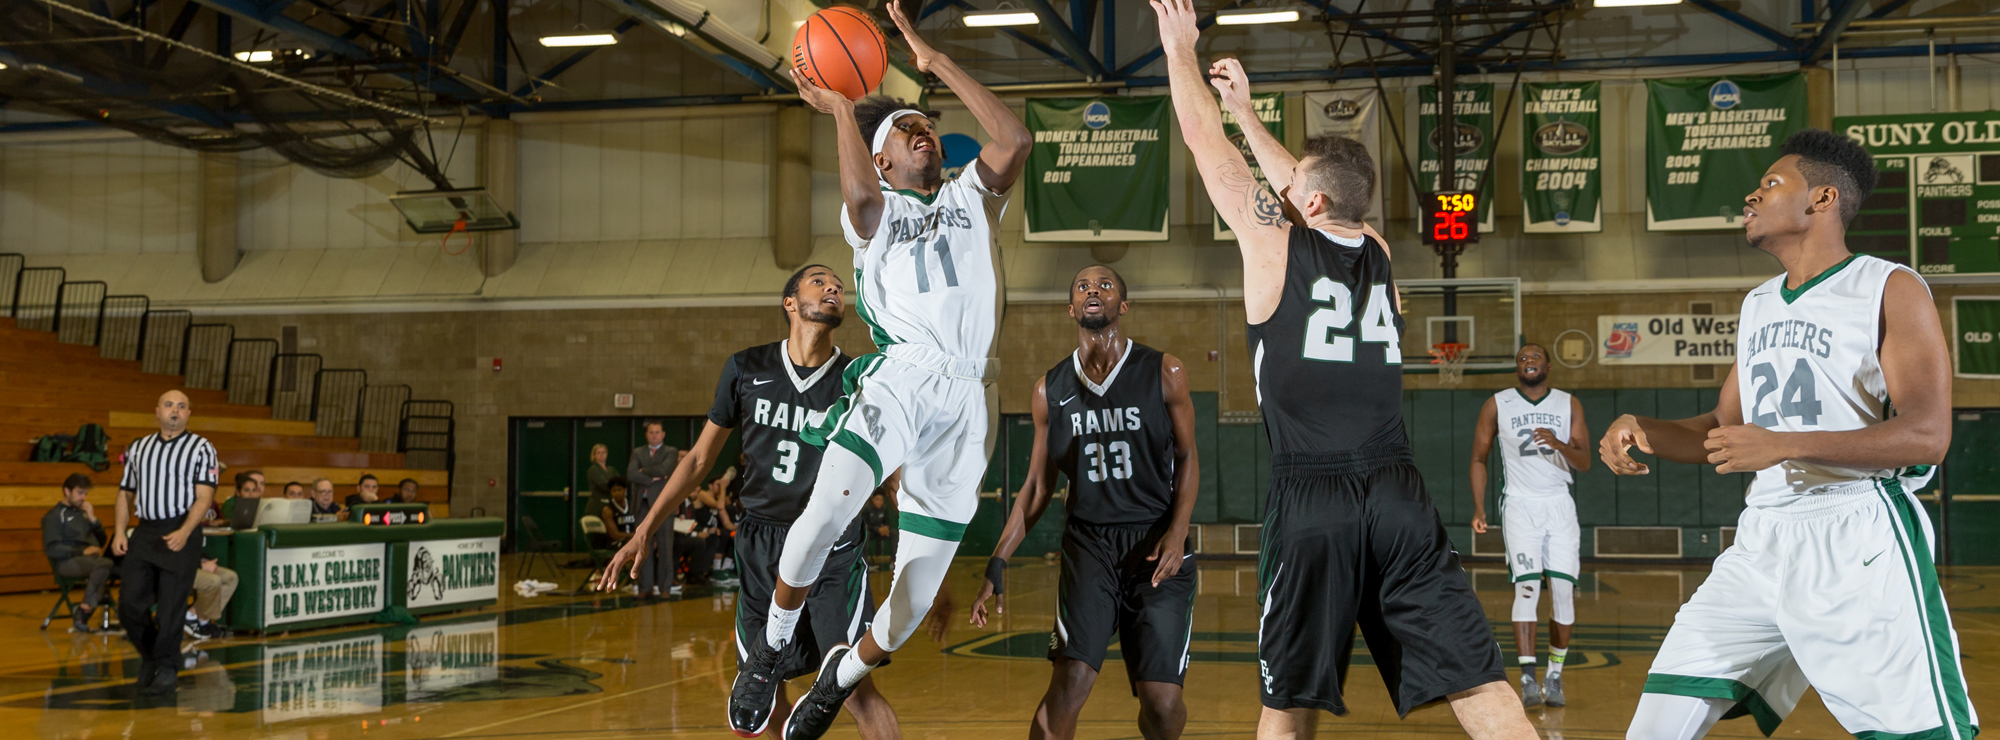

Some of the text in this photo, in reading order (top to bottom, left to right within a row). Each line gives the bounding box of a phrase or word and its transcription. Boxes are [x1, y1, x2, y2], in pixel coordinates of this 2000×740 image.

[1541, 88, 1581, 100] MEN'S
[1525, 100, 1598, 114] BASKETBALL
[1665, 108, 1786, 126] MEN'S BASKETBALL
[1035, 129, 1159, 143] WOMEN'S BASKETBALL
[1684, 122, 1769, 138] TOURNAMENT
[1846, 120, 2000, 147] SUNY OLD
[1060, 142, 1135, 155] TOURNAMENT
[1681, 135, 1772, 151] APPEARANCES
[1056, 154, 1137, 167] APPEARANCES
[1525, 158, 1598, 172] CHAMPIONS
[1665, 155, 1701, 169] 2004
[1886, 159, 1905, 168] PTS
[1043, 171, 1072, 183] 2016
[1536, 171, 1587, 190] 2004
[1667, 171, 1699, 185] 2016
[1917, 185, 1973, 198] PANTHERS
[1437, 193, 1475, 212] 7:50
[891, 205, 972, 246] PANTERS
[1433, 211, 1468, 241] 26
[1919, 227, 1951, 236] FOULS
[910, 234, 959, 294] 11
[1920, 264, 1955, 273] SCORE
[1301, 275, 1402, 365] 24
[1648, 318, 1739, 335] Old Wes
[1746, 319, 1833, 367] PANTHERS
[1963, 331, 1993, 343] OLD
[1751, 357, 1822, 428] 24
[1070, 406, 1141, 437] RAMS
[1511, 412, 1561, 430] PANTHERS
[772, 439, 800, 484] 3
[1084, 441, 1133, 482] 33
[312, 551, 336, 559] WELCOME
[325, 558, 380, 585] COLLEGE
[442, 551, 496, 591] PANTHERS
[273, 585, 377, 619] OLD WESTBURY
